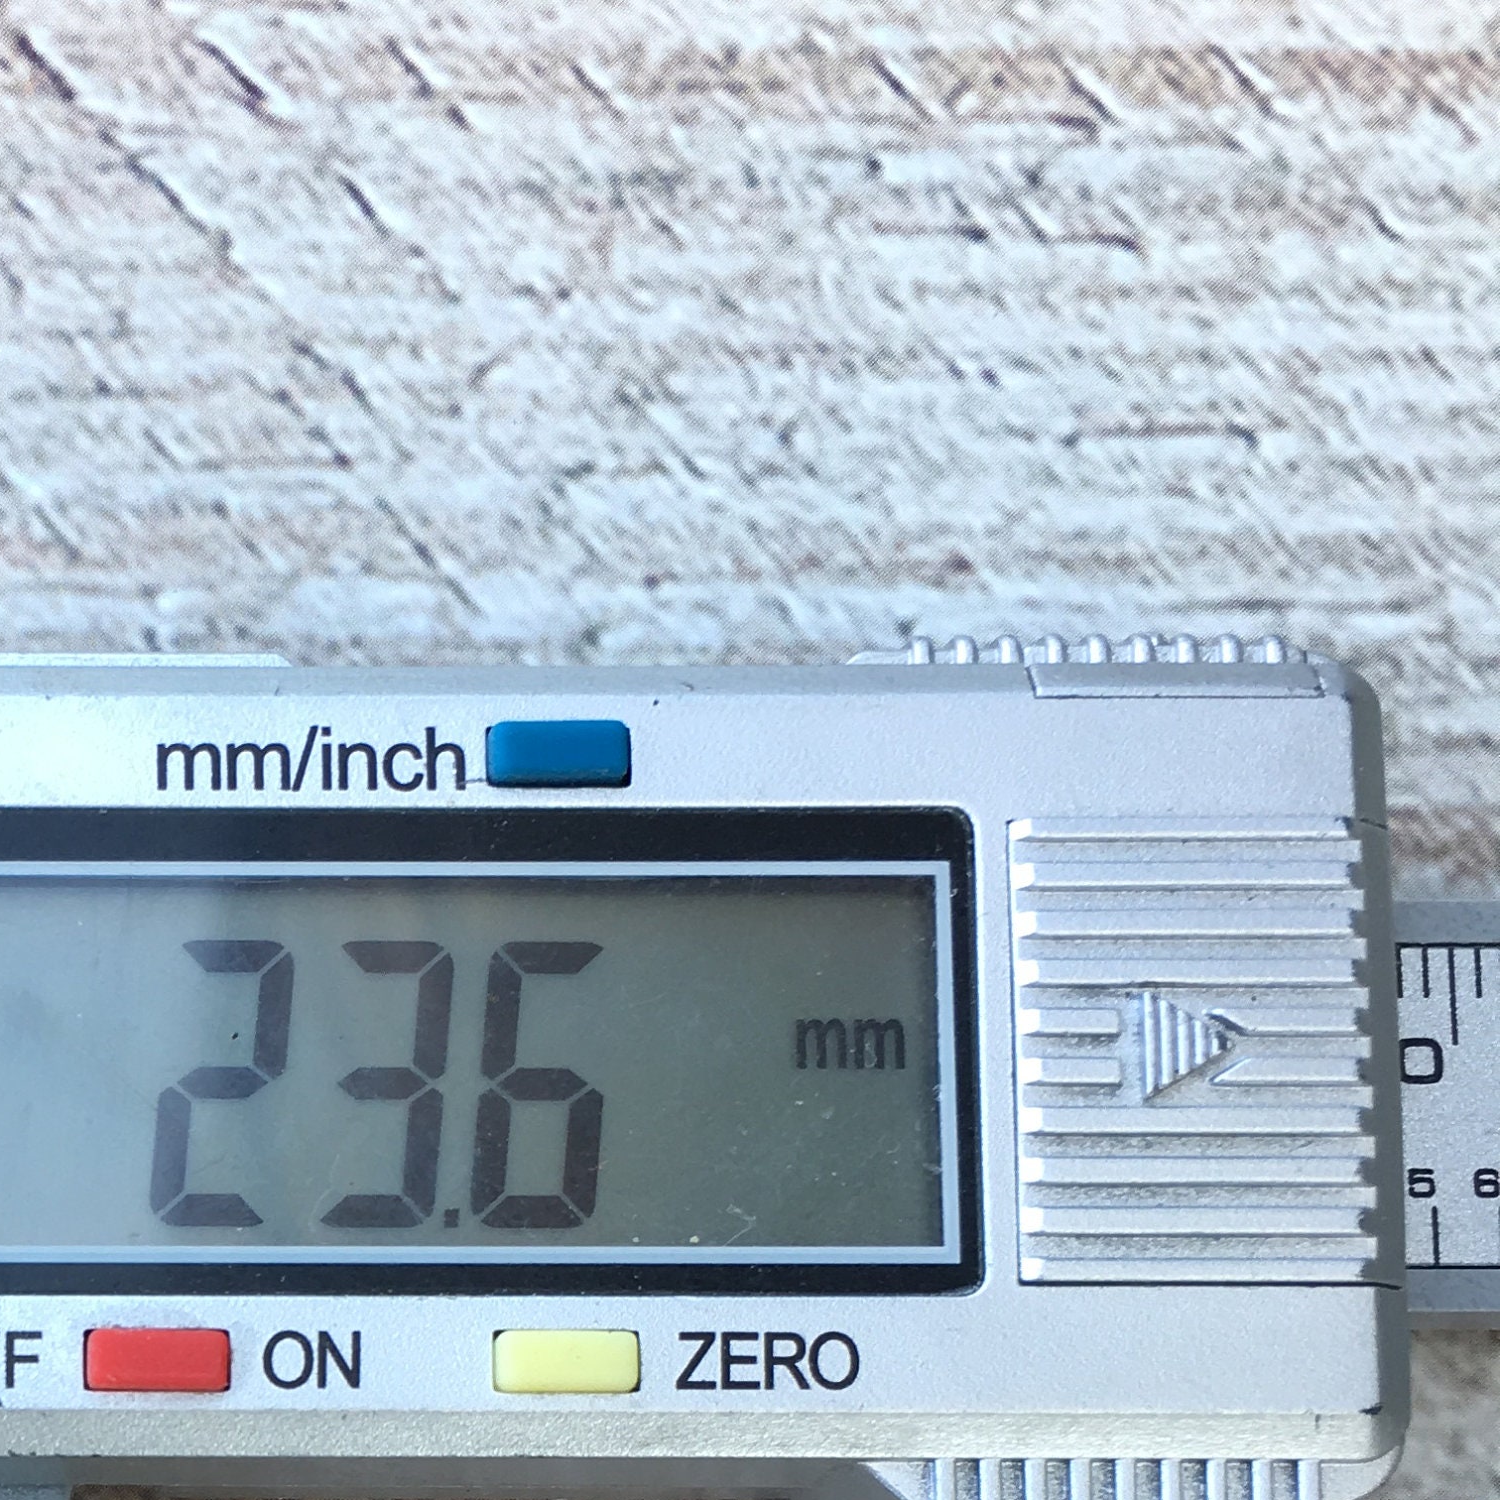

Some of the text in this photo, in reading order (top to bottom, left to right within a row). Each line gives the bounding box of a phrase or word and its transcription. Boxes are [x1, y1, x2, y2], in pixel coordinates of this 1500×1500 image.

[156, 725, 467, 792] mm/inch
[149, 940, 906, 1229] 23.6 mm
[1407, 1167, 1500, 1199] 5 6
[262, 1329, 362, 1391] ON
[674, 1329, 861, 1391] ZERO
